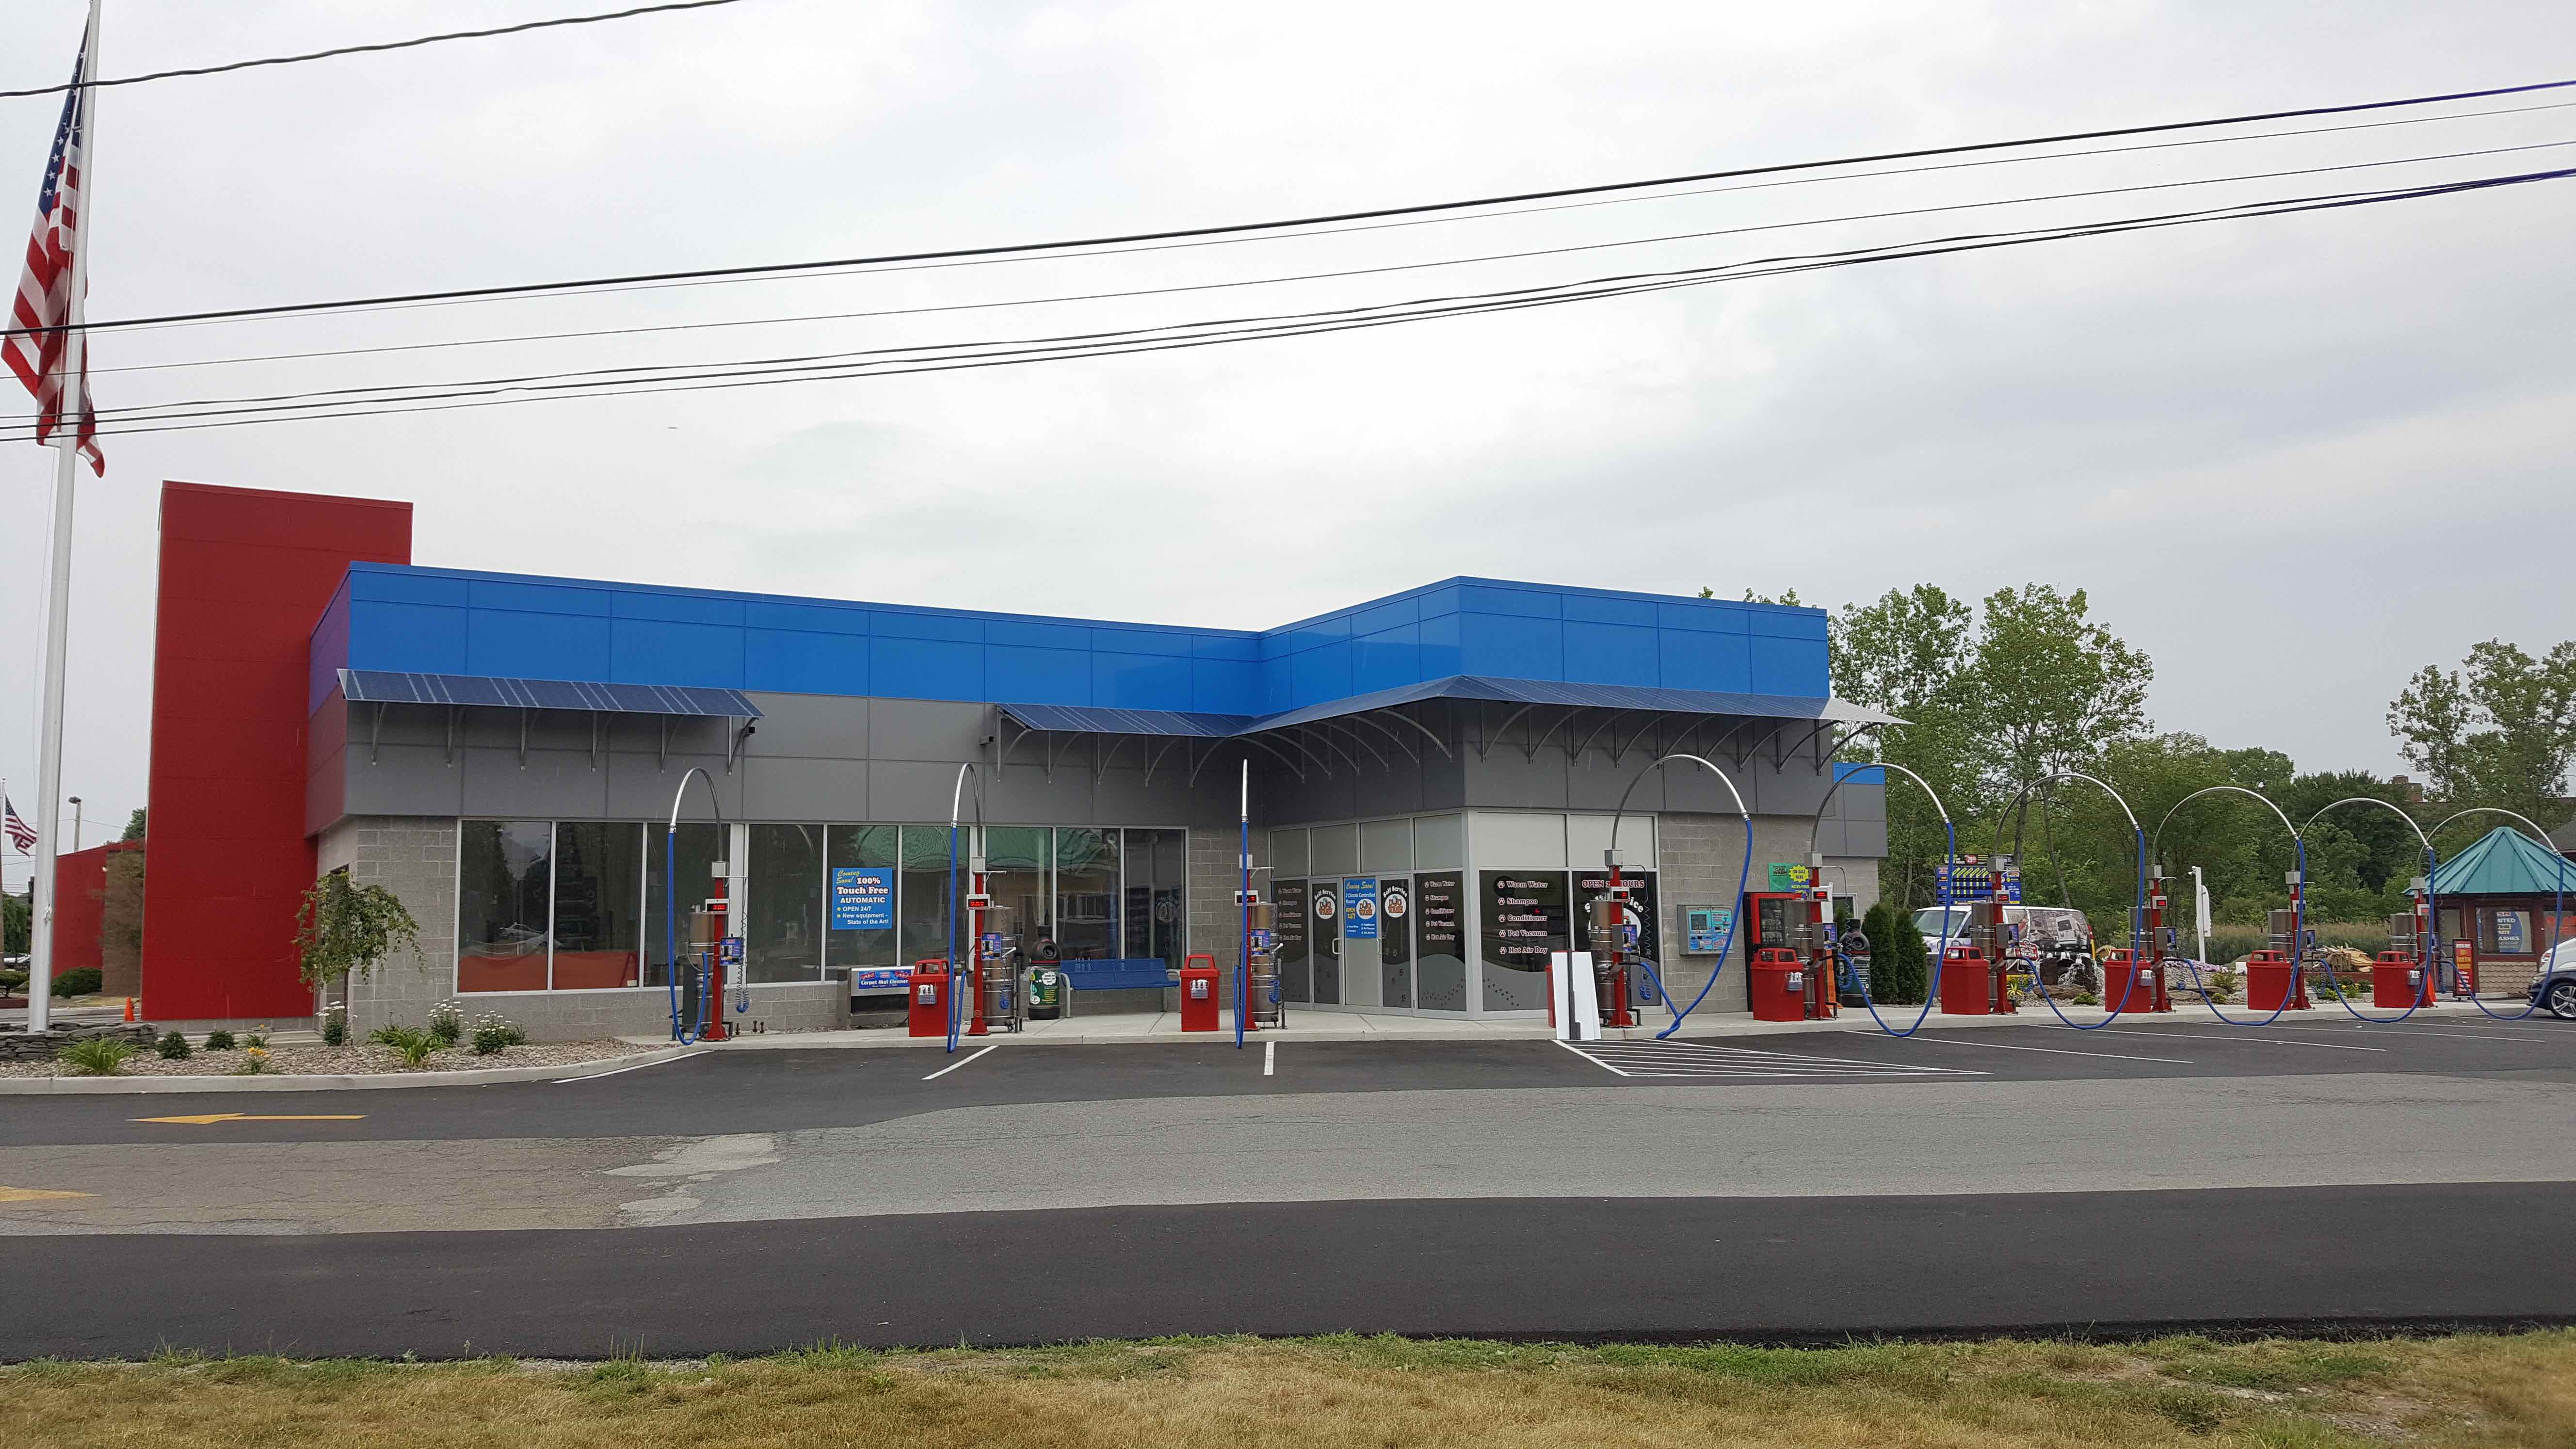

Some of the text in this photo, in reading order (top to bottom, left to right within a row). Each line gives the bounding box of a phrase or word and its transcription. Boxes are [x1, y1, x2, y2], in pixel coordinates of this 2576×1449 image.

[1582, 880, 1604, 888] OPEN
[1622, 880, 1645, 888] OURS
[1322, 889, 1336, 900] Service
[1384, 886, 1407, 898] Self Service
[1534, 946, 1548, 954] Dry
